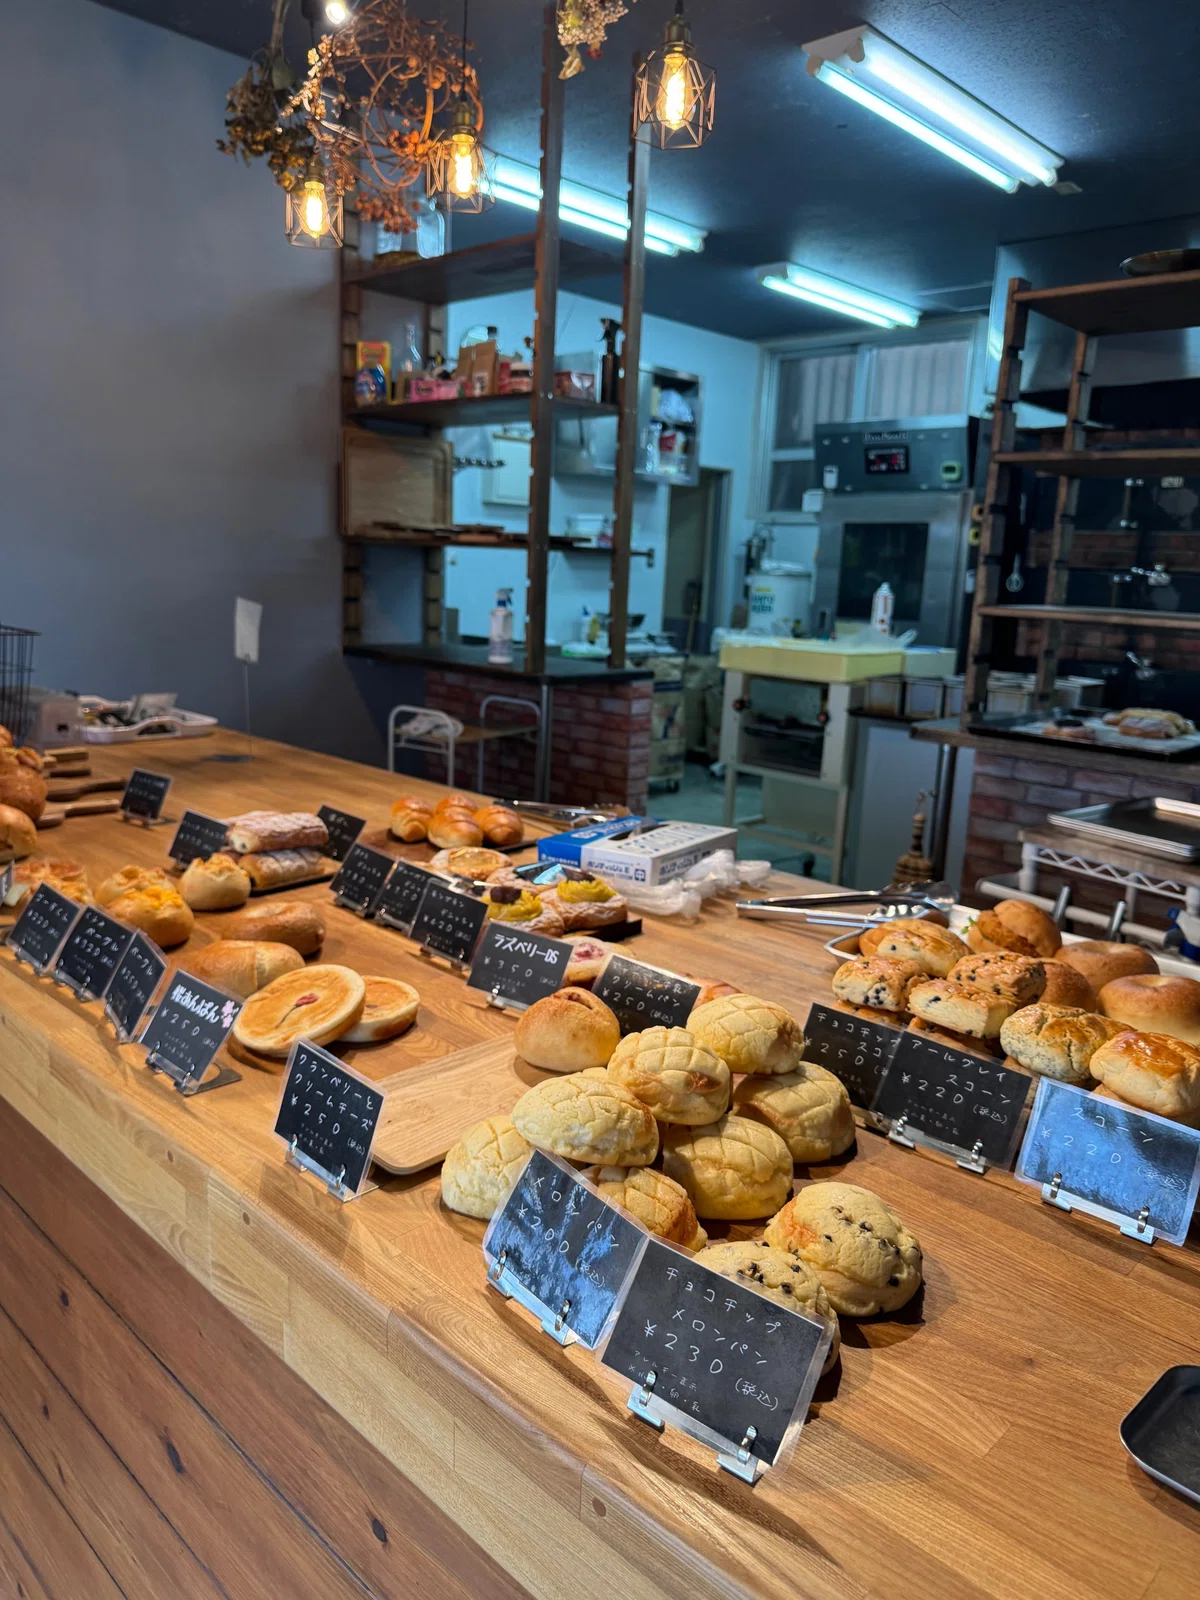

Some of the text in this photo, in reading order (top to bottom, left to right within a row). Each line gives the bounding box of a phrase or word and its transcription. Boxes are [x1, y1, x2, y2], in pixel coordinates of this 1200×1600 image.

[484, 955, 533, 978] ¥350
[493, 933, 560, 965] ラズベリーDS
[602, 987, 646, 1011] ¥250
[612, 975, 680, 1007] クリームパン
[161, 1007, 200, 1036] ¥250
[804, 1036, 864, 1065] ¥250
[911, 1039, 1007, 1083] アールグレイ
[295, 1073, 373, 1131] クリームチーズ
[300, 1053, 374, 1110] クランベリーと
[901, 1072, 1008, 1124] ¥220 (税込)
[945, 1074, 1011, 1104] スコーン
[291, 1093, 341, 1135] ¥250
[1070, 1107, 1154, 1143] スコーン
[1041, 1126, 1122, 1164] ¥220
[518, 1203, 570, 1253] ¥200
[534, 1176, 620, 1248] メロンパン
[666, 1267, 781, 1333] チョコチップ
[672, 1308, 768, 1365] メロンパン
[644, 1319, 779, 1411] ¥230 (税込)
